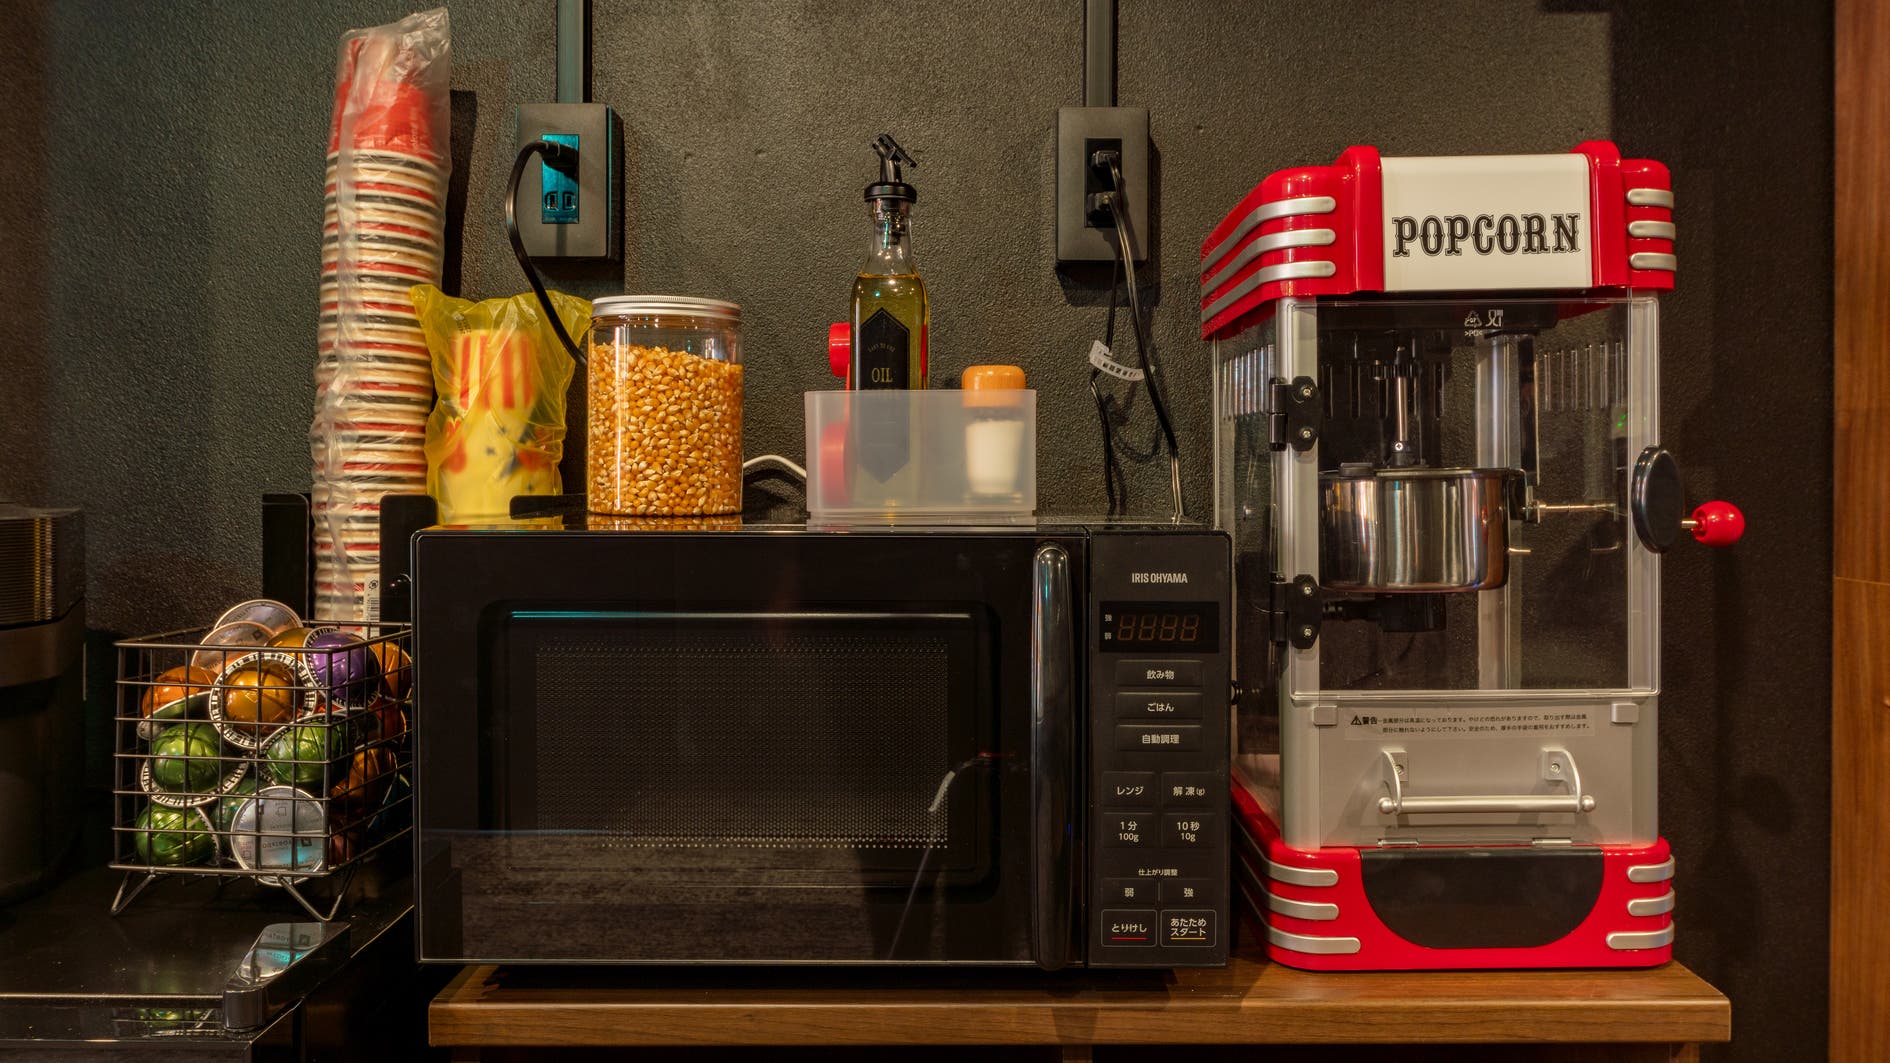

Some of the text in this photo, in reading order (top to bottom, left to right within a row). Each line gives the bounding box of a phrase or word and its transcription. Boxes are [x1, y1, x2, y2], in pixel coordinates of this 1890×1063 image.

[1391, 212, 1582, 258] POPCORN
[871, 367, 893, 383] OIL
[1131, 572, 1188, 584] IRIS OHYAMA
[1146, 669, 1175, 680] 飲み物
[1147, 702, 1175, 712] ごはん
[1141, 733, 1180, 745] 自動調理
[1116, 786, 1144, 796] レンジ
[1118, 832, 1139, 843] 100g
[1180, 832, 1196, 843] 10g
[1137, 868, 1178, 877] 仕上がり調整
[1124, 887, 1135, 898] 弱
[1183, 887, 1194, 898] 強
[1111, 923, 1148, 933] とりけし
[1170, 917, 1207, 928] あたため
[1170, 927, 1207, 937] スタート
